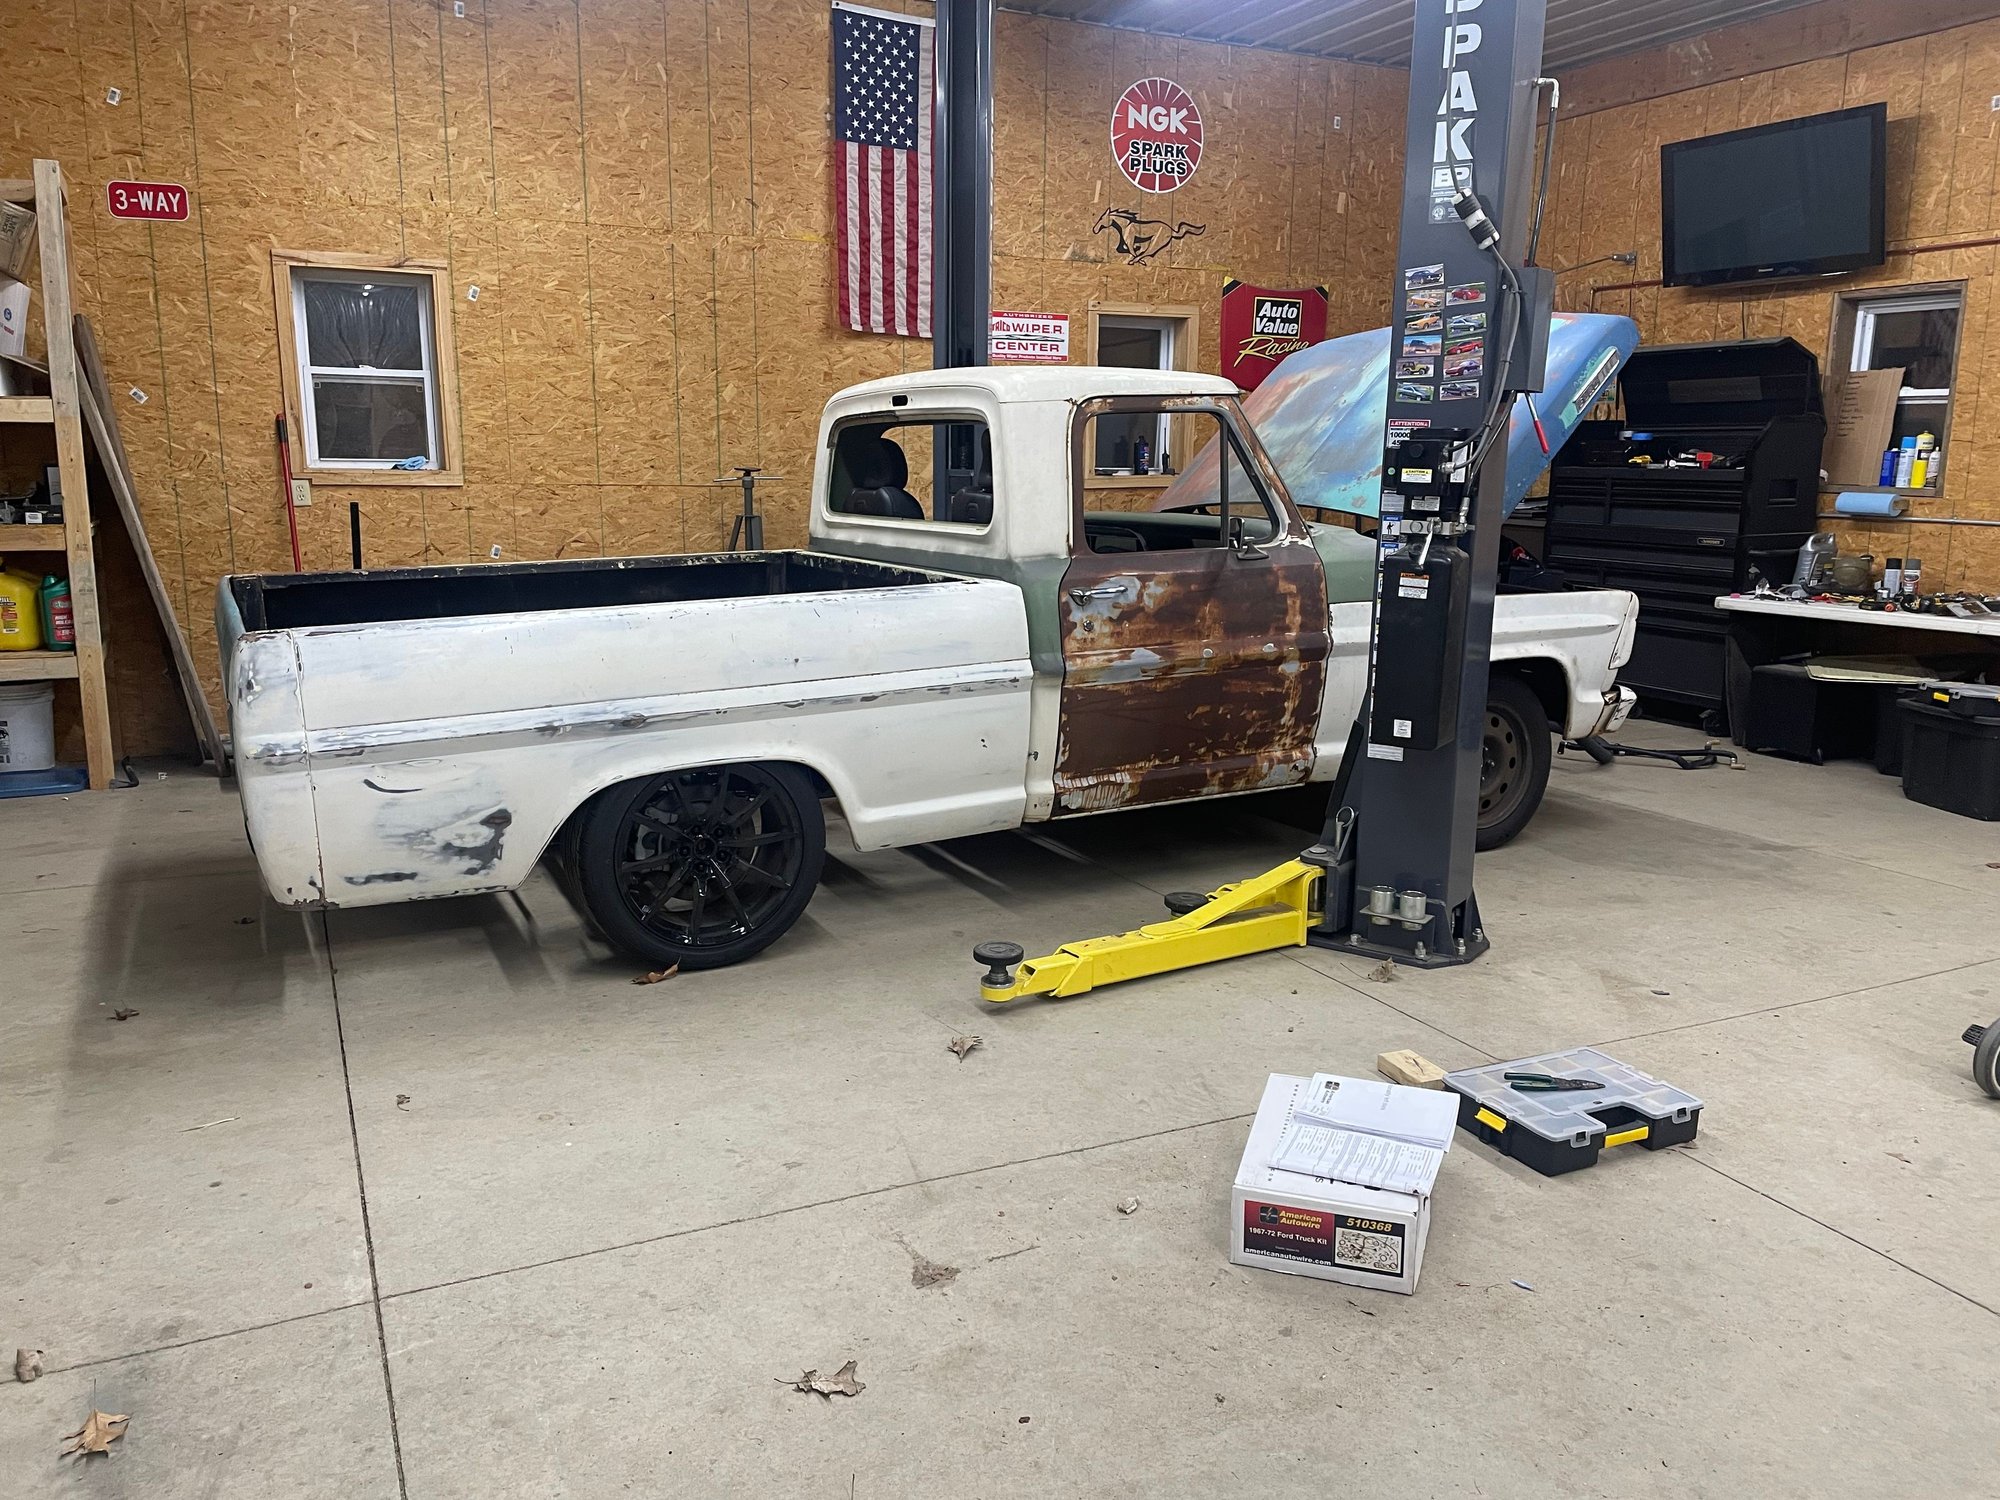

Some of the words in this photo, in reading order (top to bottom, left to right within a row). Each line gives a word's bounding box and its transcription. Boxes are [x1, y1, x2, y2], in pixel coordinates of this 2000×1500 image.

[1433, 0, 1483, 162] PAK
[1127, 104, 1189, 135] NGK
[1129, 140, 1187, 160] SPARK
[1129, 157, 1188, 176] PLUGS
[115, 189, 181, 213] 3-WAY
[1258, 301, 1298, 319] Auto
[1255, 317, 1299, 335] Value
[995, 341, 1060, 353] CENTER
[1279, 1210, 1323, 1223] American
[1280, 1218, 1321, 1230] Autowire
[1346, 1217, 1393, 1232] 510368
[1277, 1231, 1294, 1240] Ford
[1294, 1233, 1317, 1244] Truck
[1316, 1237, 1328, 1246] Kit
[1245, 1247, 1332, 1266] americanautowire.com
